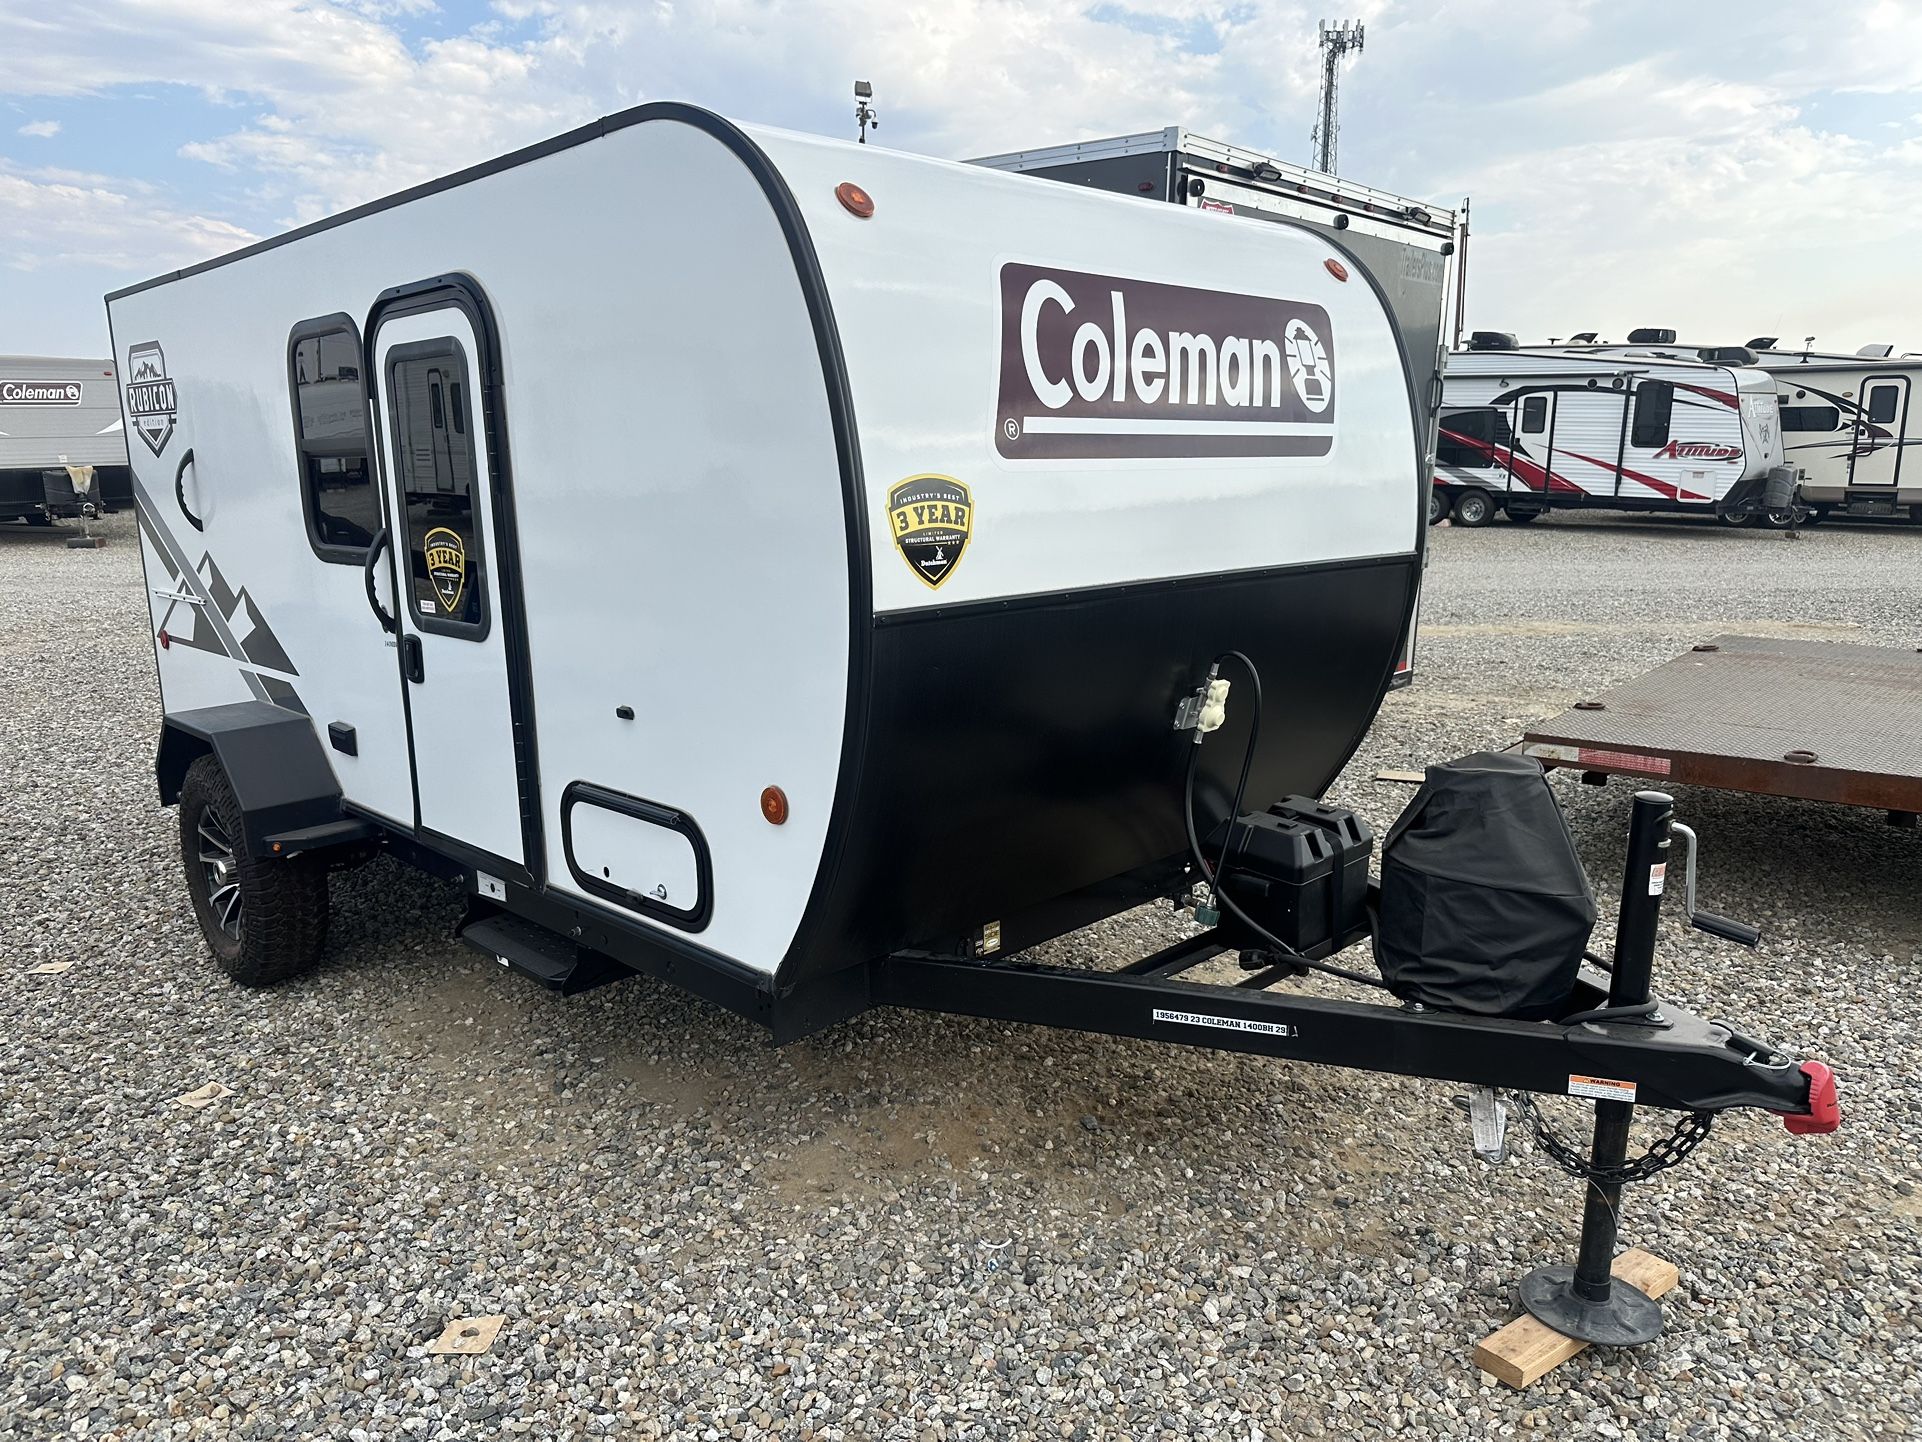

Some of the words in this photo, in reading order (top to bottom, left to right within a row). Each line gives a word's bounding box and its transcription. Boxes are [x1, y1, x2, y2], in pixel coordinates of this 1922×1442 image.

[1020, 279, 1281, 409] Coleman
[3, 384, 65, 400] Coleman
[129, 385, 174, 412] RUBICON
[900, 493, 940, 504] INDUSTRY'S
[896, 511, 909, 531] 3
[913, 505, 965, 526] YEAR
[429, 552, 435, 566] 3
[436, 550, 460, 568] YEAR
[1155, 1010, 1189, 1022] 1956479
[1190, 1015, 1201, 1024] 23
[1202, 1017, 1241, 1028] COLEMAN
[1242, 1022, 1274, 1033] 1400BH
[1590, 1079, 1620, 1087] WARNING
